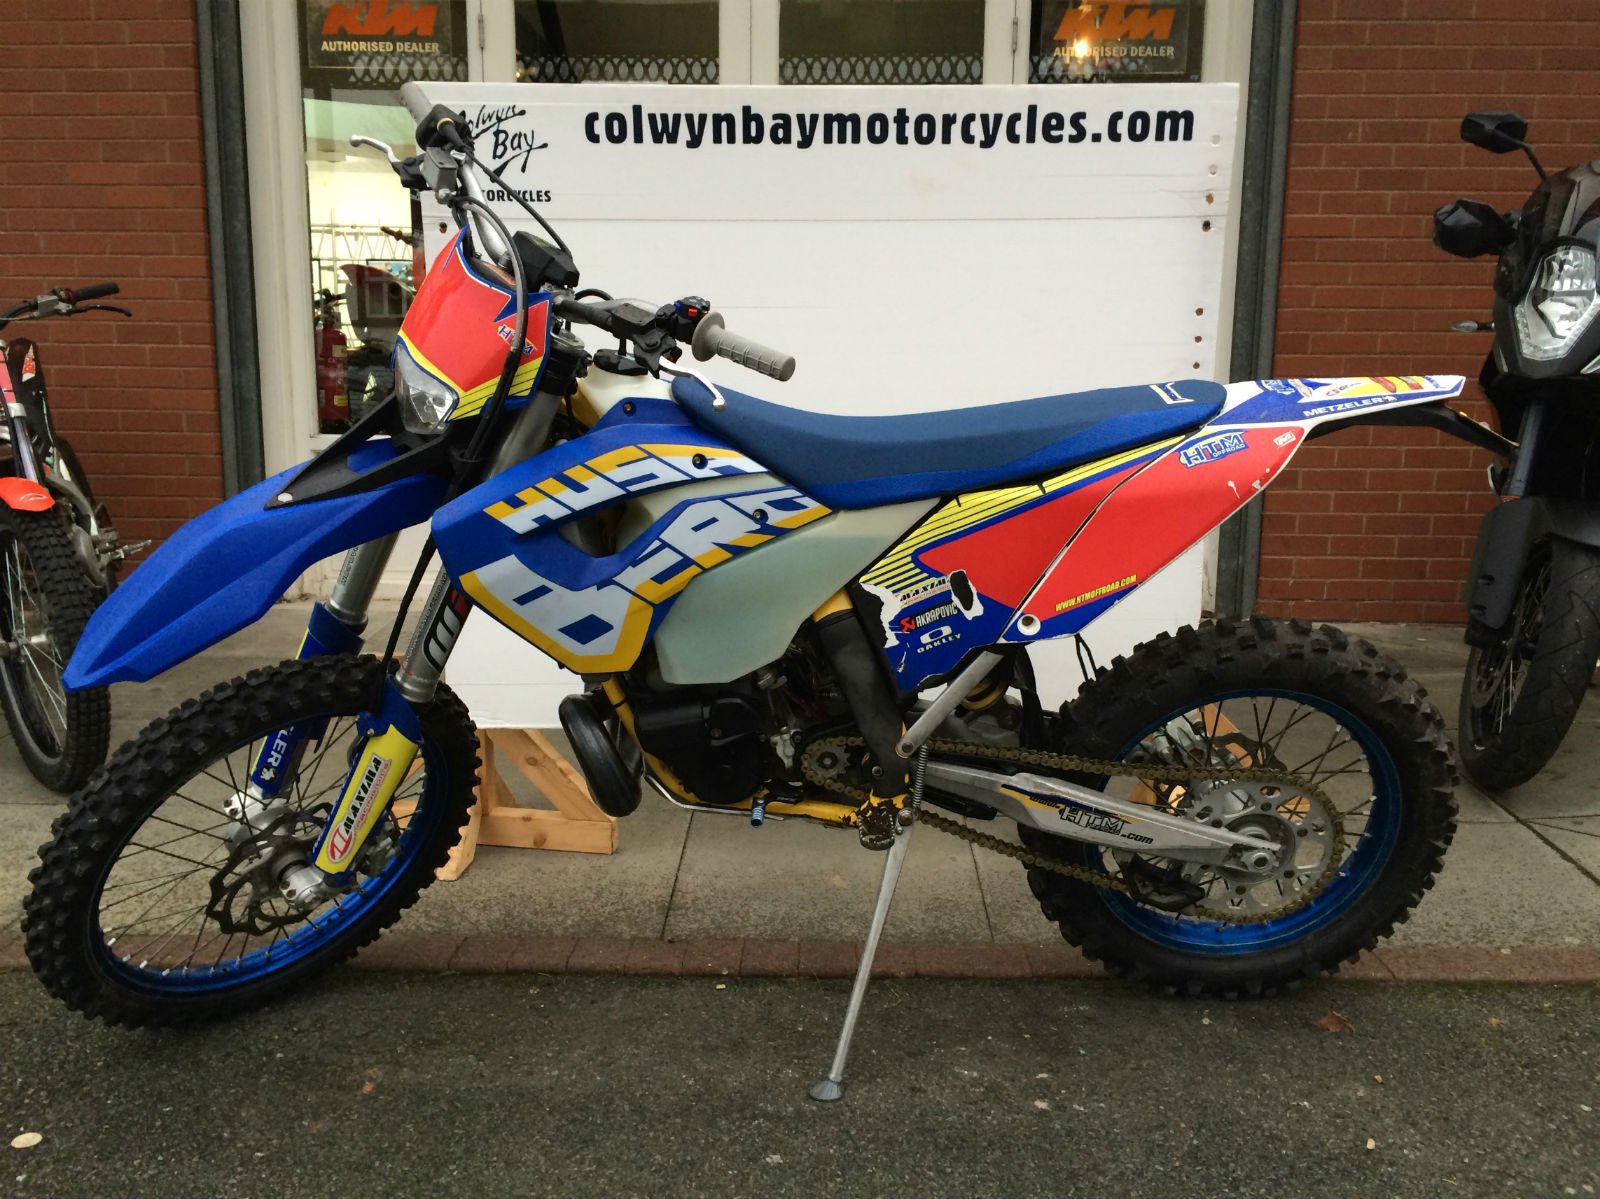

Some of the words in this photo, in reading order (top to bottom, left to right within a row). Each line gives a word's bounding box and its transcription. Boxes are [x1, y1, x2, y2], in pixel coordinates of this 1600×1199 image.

[320, 0, 438, 36] KTM
[1053, 0, 1177, 40] KTM
[320, 41, 394, 52] AUTHORISED
[396, 41, 440, 53] DEALER
[1053, 46, 1127, 57] AUTORISED
[1130, 46, 1175, 57] DEALER
[584, 104, 1194, 149] colwynbaymotorcycles.com
[491, 128, 549, 174] Bay
[1303, 396, 1383, 417] METZELER
[1181, 433, 1246, 468] HTM
[900, 576, 951, 602] MAXIM
[1055, 574, 1138, 612] WWW.HTMOFFROAD.COM
[916, 633, 961, 654] OAKLEY
[342, 756, 383, 836] MAXIMA
